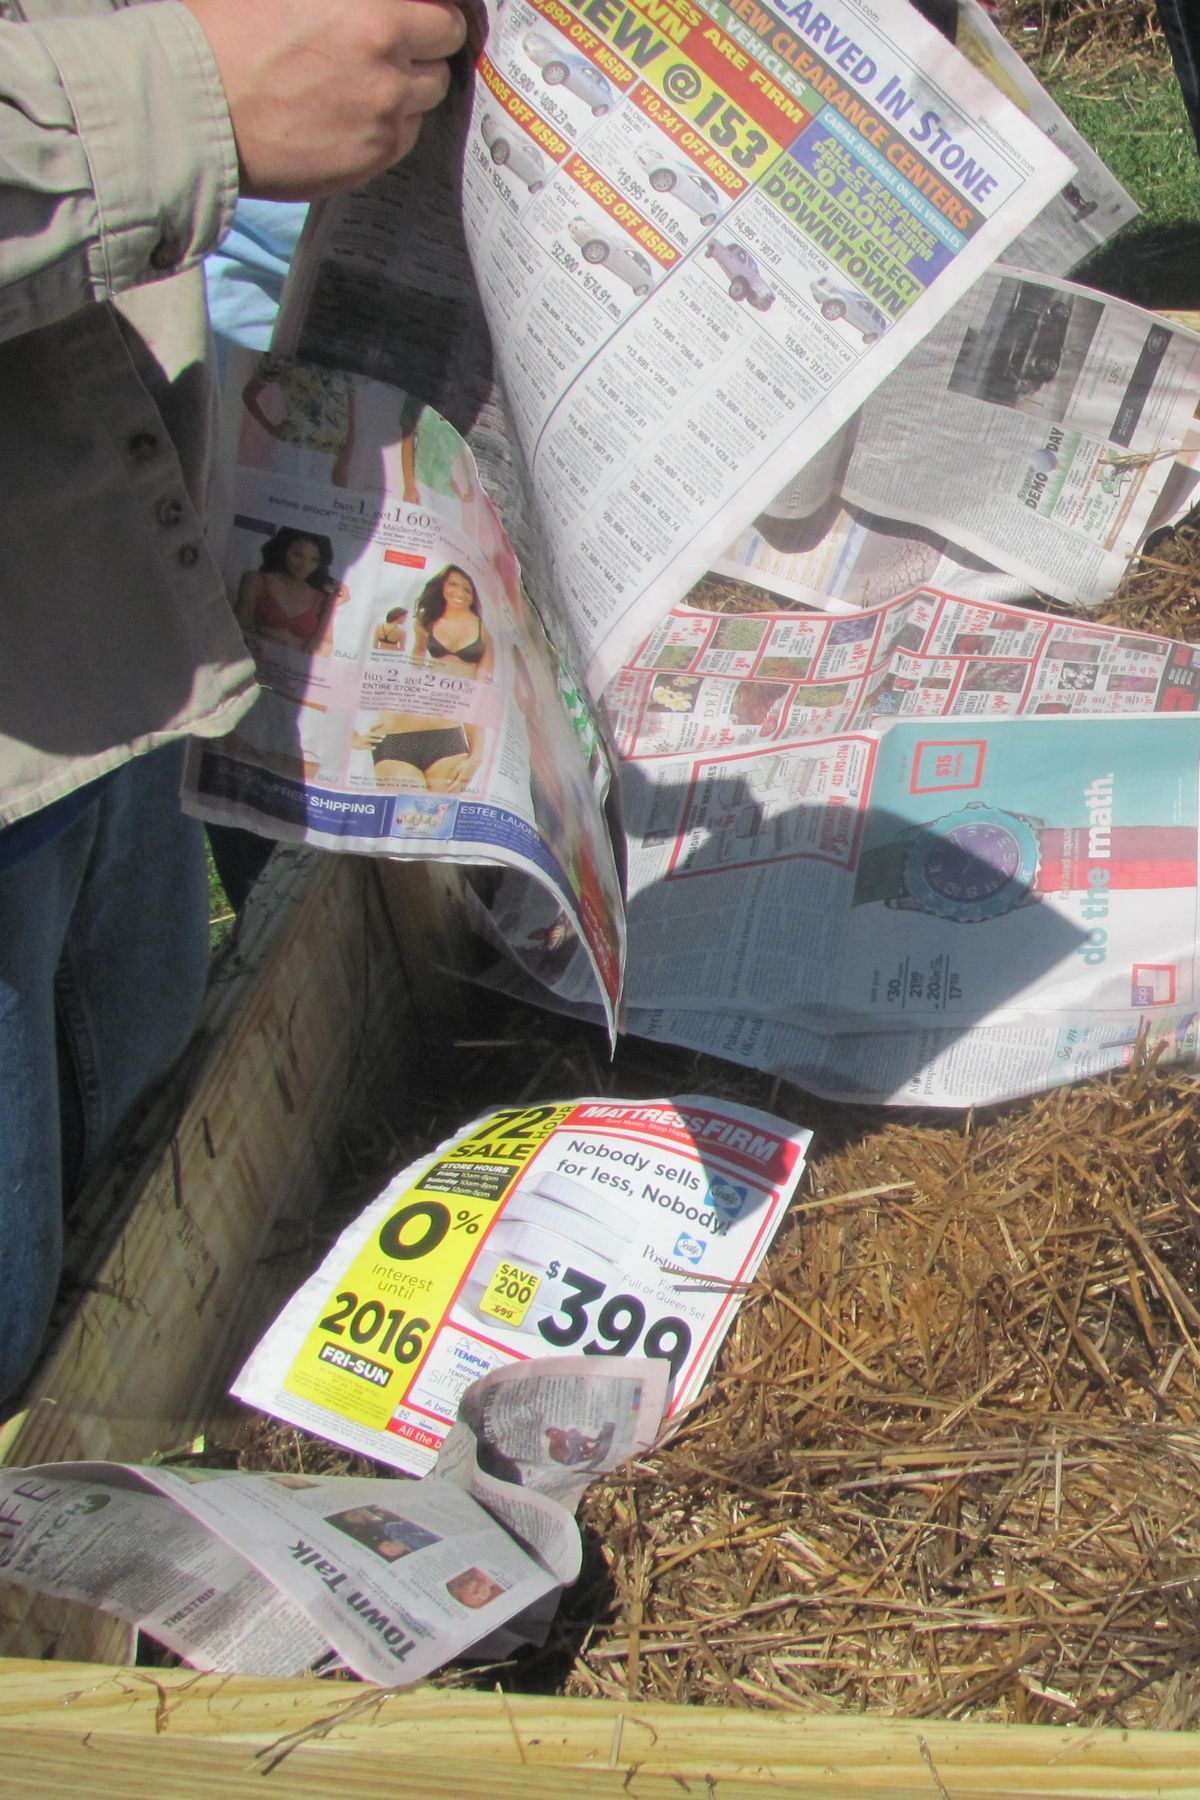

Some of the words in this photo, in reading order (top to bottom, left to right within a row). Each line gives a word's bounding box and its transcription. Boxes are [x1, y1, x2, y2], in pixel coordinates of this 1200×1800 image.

[567, 22, 598, 53] OFF
[592, 45, 633, 86] MSRP
[699, 24, 751, 74] ARE
[745, 66, 806, 125] FIRM
[719, 14, 809, 99] VEHICLES
[505, 95, 534, 125] OFF
[527, 117, 568, 158] MSRP
[635, 86, 684, 135] $10,341
[678, 128, 709, 160] OFF
[703, 152, 744, 193] MSRP
[663, 63, 702, 105] @
[690, 89, 772, 173] 153
[765, 29, 892, 150] CLEARANCE
[880, 139, 977, 231] CENTERS
[822, 110, 859, 146] CARFAX
[853, 141, 899, 186] AVAILABLE
[922, 208, 963, 249] VEHICLES
[906, 107, 1005, 204] STONE
[567, 158, 616, 207] $24,655
[612, 200, 641, 230] OFF
[635, 223, 677, 265] MSRP
[810, 140, 865, 194] PRICES
[861, 190, 895, 224] ARE
[893, 221, 934, 262] FIRM
[823, 136, 852, 164] ALL
[852, 164, 938, 249] CLEARANCE
[835, 185, 916, 265] DOWN
[761, 174, 908, 317] DOWNTOWN
[777, 158, 821, 203] MTN
[813, 193, 862, 242] VIEW
[855, 235, 921, 301] SELECT
[1023, 470, 1049, 510] DEMO
[1044, 426, 1065, 453] DAY
[310, 796, 376, 815] SHIPPING
[1082, 771, 1114, 858] math.
[1079, 866, 1110, 920] the
[1076, 926, 1108, 965] do
[448, 1142, 536, 1162] SALE
[468, 1106, 551, 1142] 72
[440, 1162, 474, 1170] STORE
[474, 1164, 509, 1173] HOURS
[556, 1158, 583, 1178] for
[589, 1163, 637, 1198] less,
[641, 1182, 733, 1236] Nobody!
[566, 1139, 651, 1175] Nobody
[655, 1160, 702, 1191] sells
[371, 1262, 435, 1295] Interest
[377, 1278, 418, 1301] until
[499, 1263, 538, 1287] SAVE
[621, 1273, 642, 1289] Full
[642, 1285, 655, 1296] or
[655, 1291, 688, 1312] Queen
[689, 1306, 706, 1321] Set
[319, 1292, 431, 1364] 2016
[319, 1344, 390, 1386] FRI-SUN
[455, 1361, 484, 1379] Introdu
[397, 1422, 413, 1436] All
[414, 1429, 433, 1445] the
[433, 1400, 452, 1415] bed
[285, 1535, 351, 1592] Talk
[344, 1591, 420, 1658] Town
